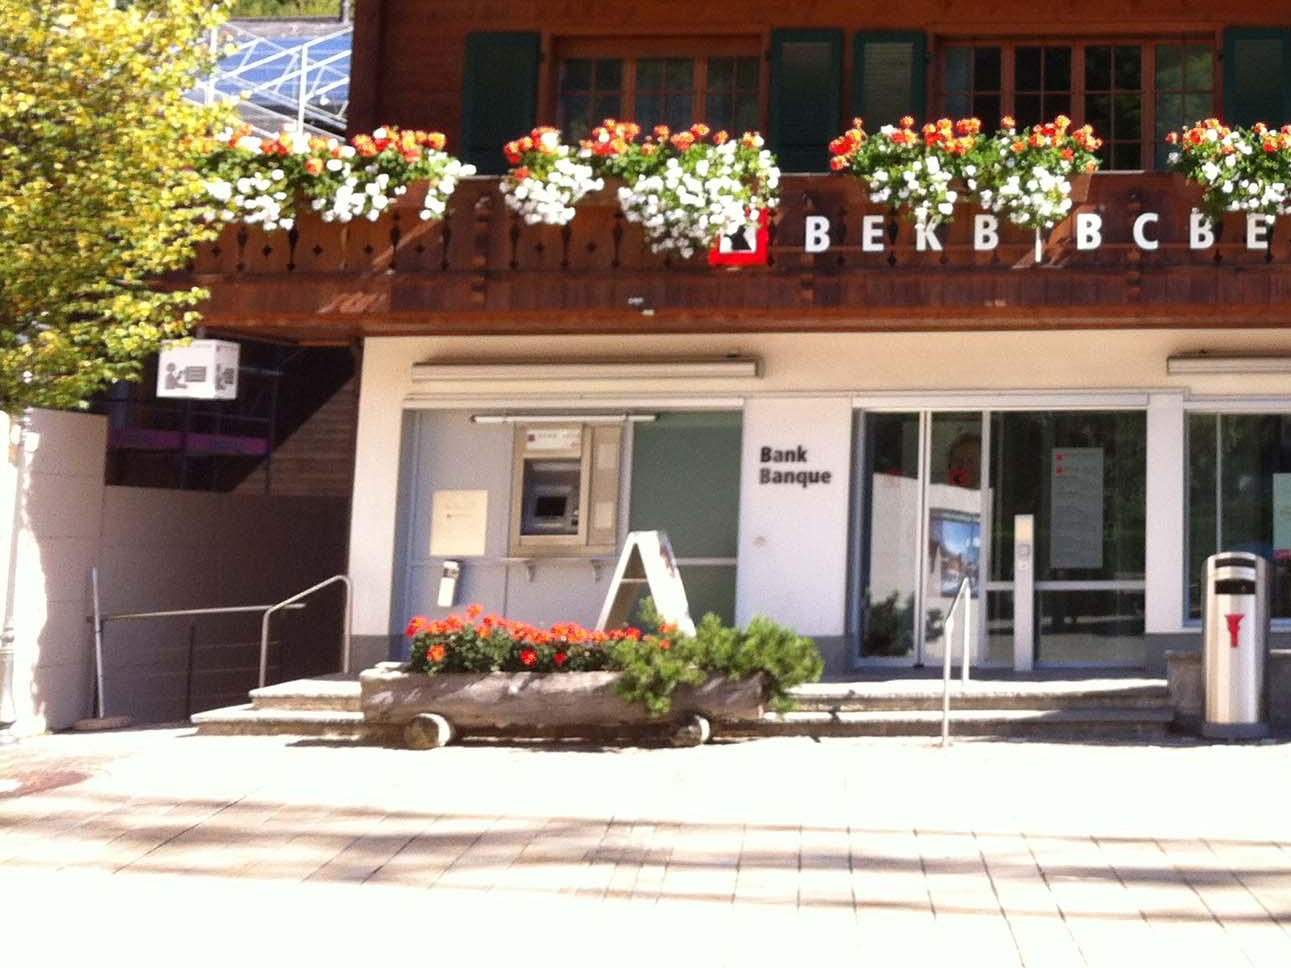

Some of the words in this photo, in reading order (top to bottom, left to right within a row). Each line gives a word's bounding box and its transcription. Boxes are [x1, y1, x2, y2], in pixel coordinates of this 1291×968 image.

[805, 214, 999, 253] BEKB
[1076, 212, 1270, 250] BCBE
[760, 445, 808, 463] Bank
[759, 468, 832, 489] Banque
